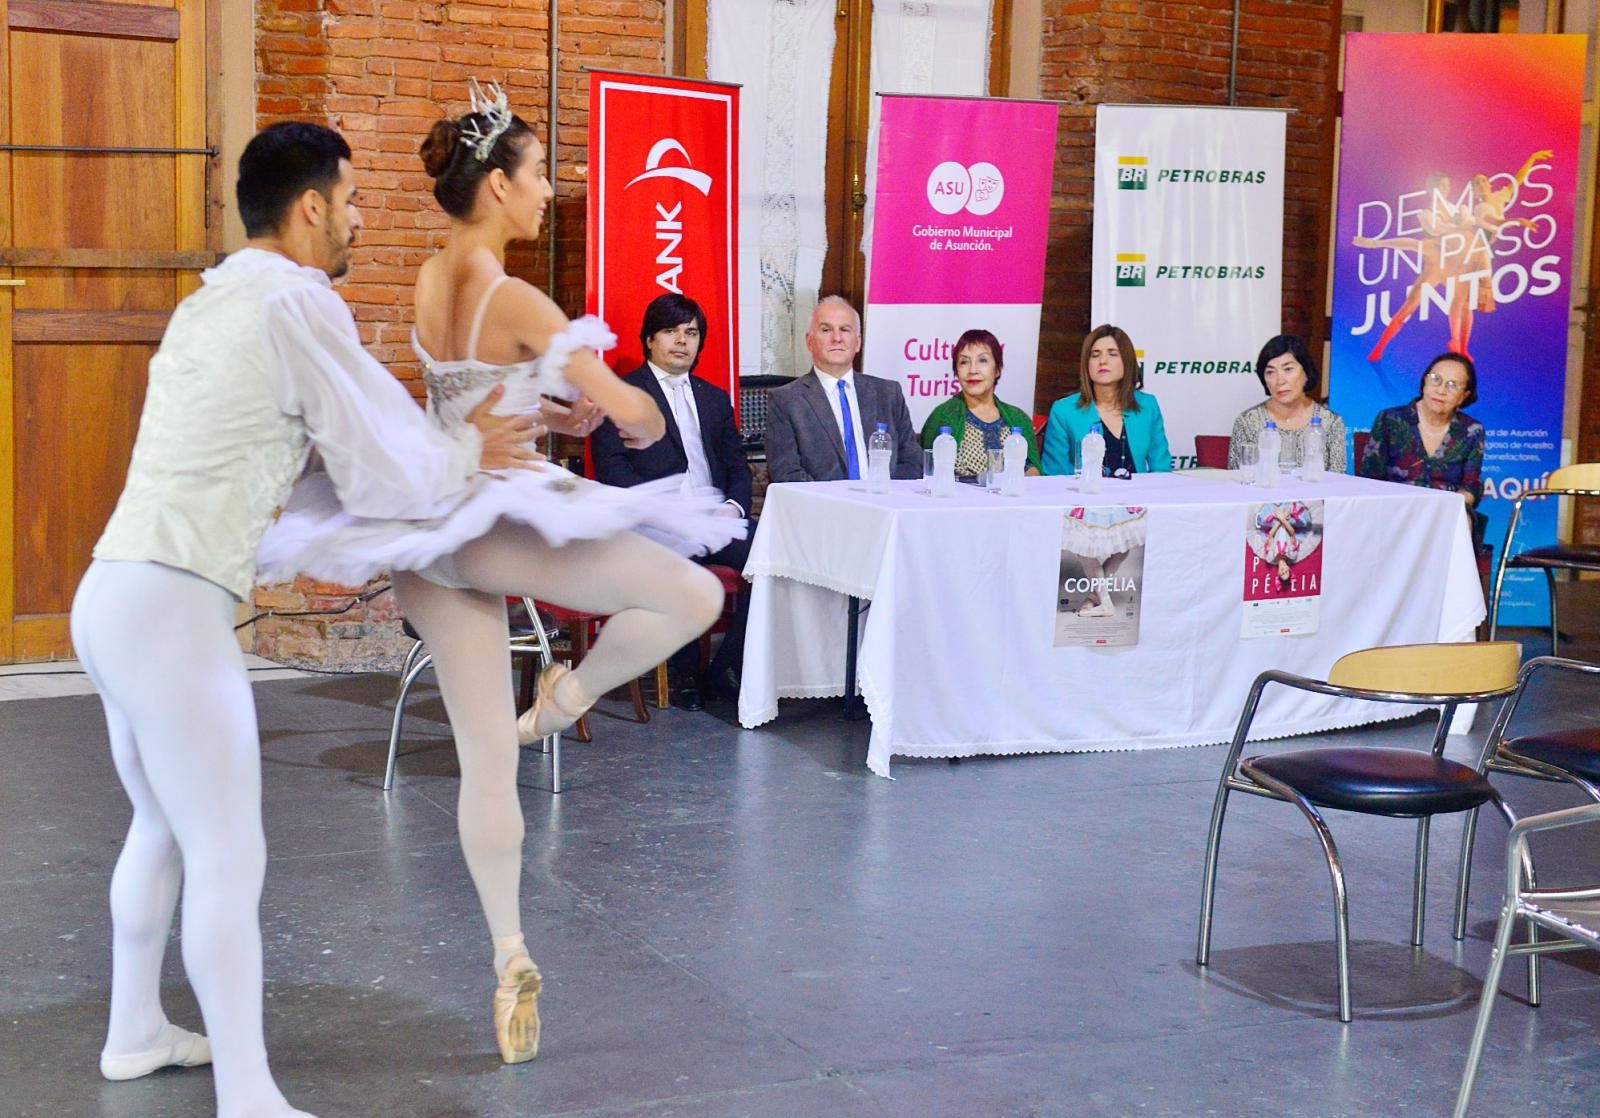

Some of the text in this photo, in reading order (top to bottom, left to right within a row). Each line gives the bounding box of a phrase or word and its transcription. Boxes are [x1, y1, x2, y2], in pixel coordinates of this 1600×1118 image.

[1157, 169, 1266, 184] PETROBRAS
[934, 181, 964, 195] ASU
[1358, 164, 1553, 240] DEMOS
[912, 224, 1013, 241] Gobierno Municipal
[929, 238, 994, 251] de Asunción.
[1358, 213, 1557, 286] UN PASO
[1156, 266, 1265, 280] PETROBRAS
[1350, 255, 1561, 335] JUNTOS
[1155, 361, 1257, 374] PETROBRA
[1483, 472, 1549, 500] AQUÍ
[1064, 574, 1137, 593] COPPÉLIA
